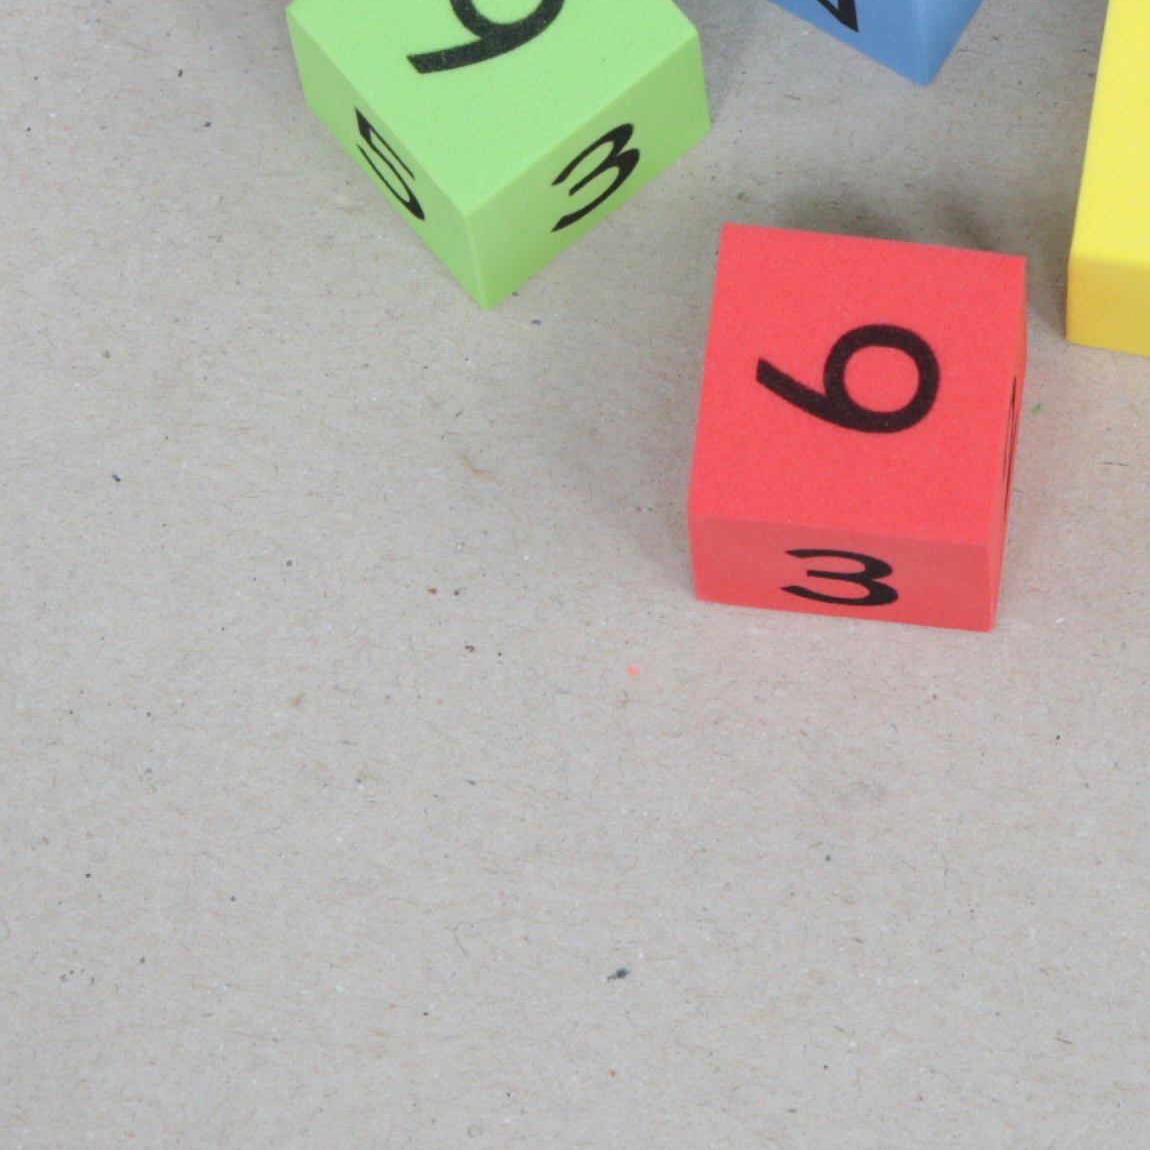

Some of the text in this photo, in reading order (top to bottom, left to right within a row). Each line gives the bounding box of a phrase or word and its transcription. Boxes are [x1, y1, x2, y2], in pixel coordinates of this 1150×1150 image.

[354, 106, 426, 221] 5
[550, 122, 641, 233] 3
[782, 548, 899, 607] 3
